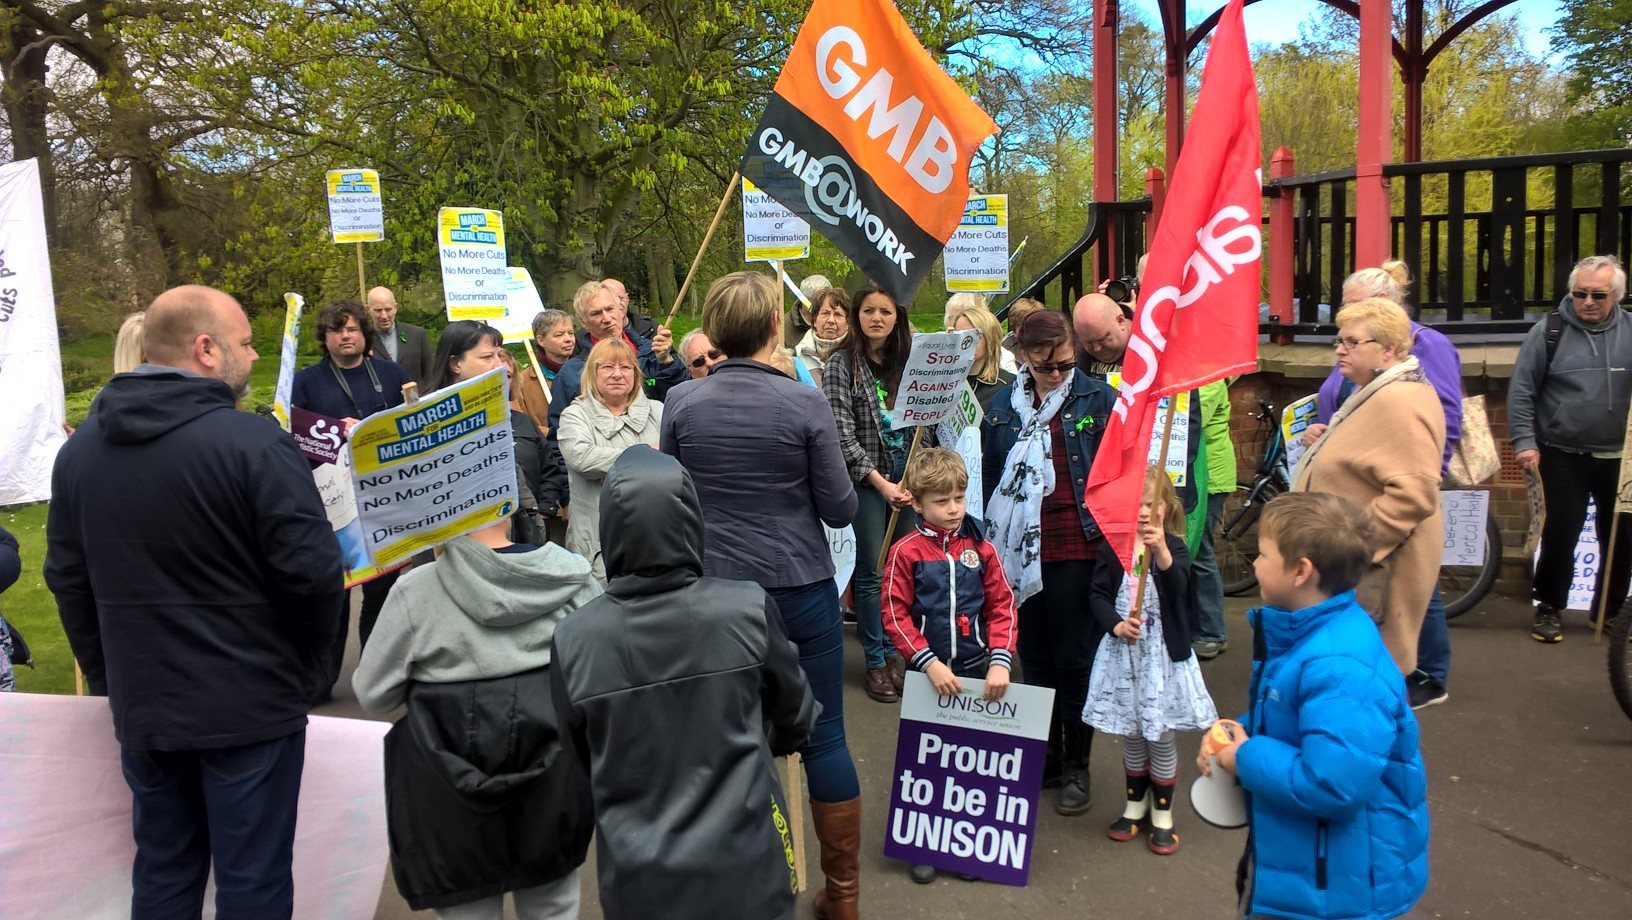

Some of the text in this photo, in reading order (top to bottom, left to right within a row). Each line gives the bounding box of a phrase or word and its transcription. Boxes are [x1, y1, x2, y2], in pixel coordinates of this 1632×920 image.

[816, 25, 958, 194] GMB
[745, 195, 778, 203] No Mo
[460, 214, 486, 226] MARCH
[976, 215, 997, 224] HEALTH
[451, 230, 496, 243] MENTAL HEALTH
[747, 234, 808, 242] Discrimination
[984, 230, 1007, 239] Cuts
[443, 250, 505, 260] No More Cuts
[482, 267, 506, 275] Deaths
[947, 267, 1007, 275] Discrimination
[448, 292, 508, 301] Discrimination
[910, 367, 966, 376] Discriminating
[907, 393, 954, 405] Disabled
[401, 398, 458, 433] MARCH
[426, 424, 439, 432] FOR
[294, 433, 331, 450] The National
[380, 435, 435, 460] MENTAL
[438, 410, 485, 442] HEALTH
[1151, 432, 1186, 441] Deths
[315, 447, 338, 460] Society
[360, 430, 507, 490] No More Cuts
[363, 451, 508, 511] No More Deaths
[432, 490, 454, 505] or
[372, 484, 510, 543] Discrimination
[828, 529, 852, 553] lth
[938, 694, 1017, 717] UNISON
[949, 714, 971, 722] public
[972, 717, 998, 726] service
[999, 721, 1022, 730] union
[917, 732, 1023, 781] Proud
[900, 770, 1029, 825] to be in
[892, 808, 1027, 870] UNISON
